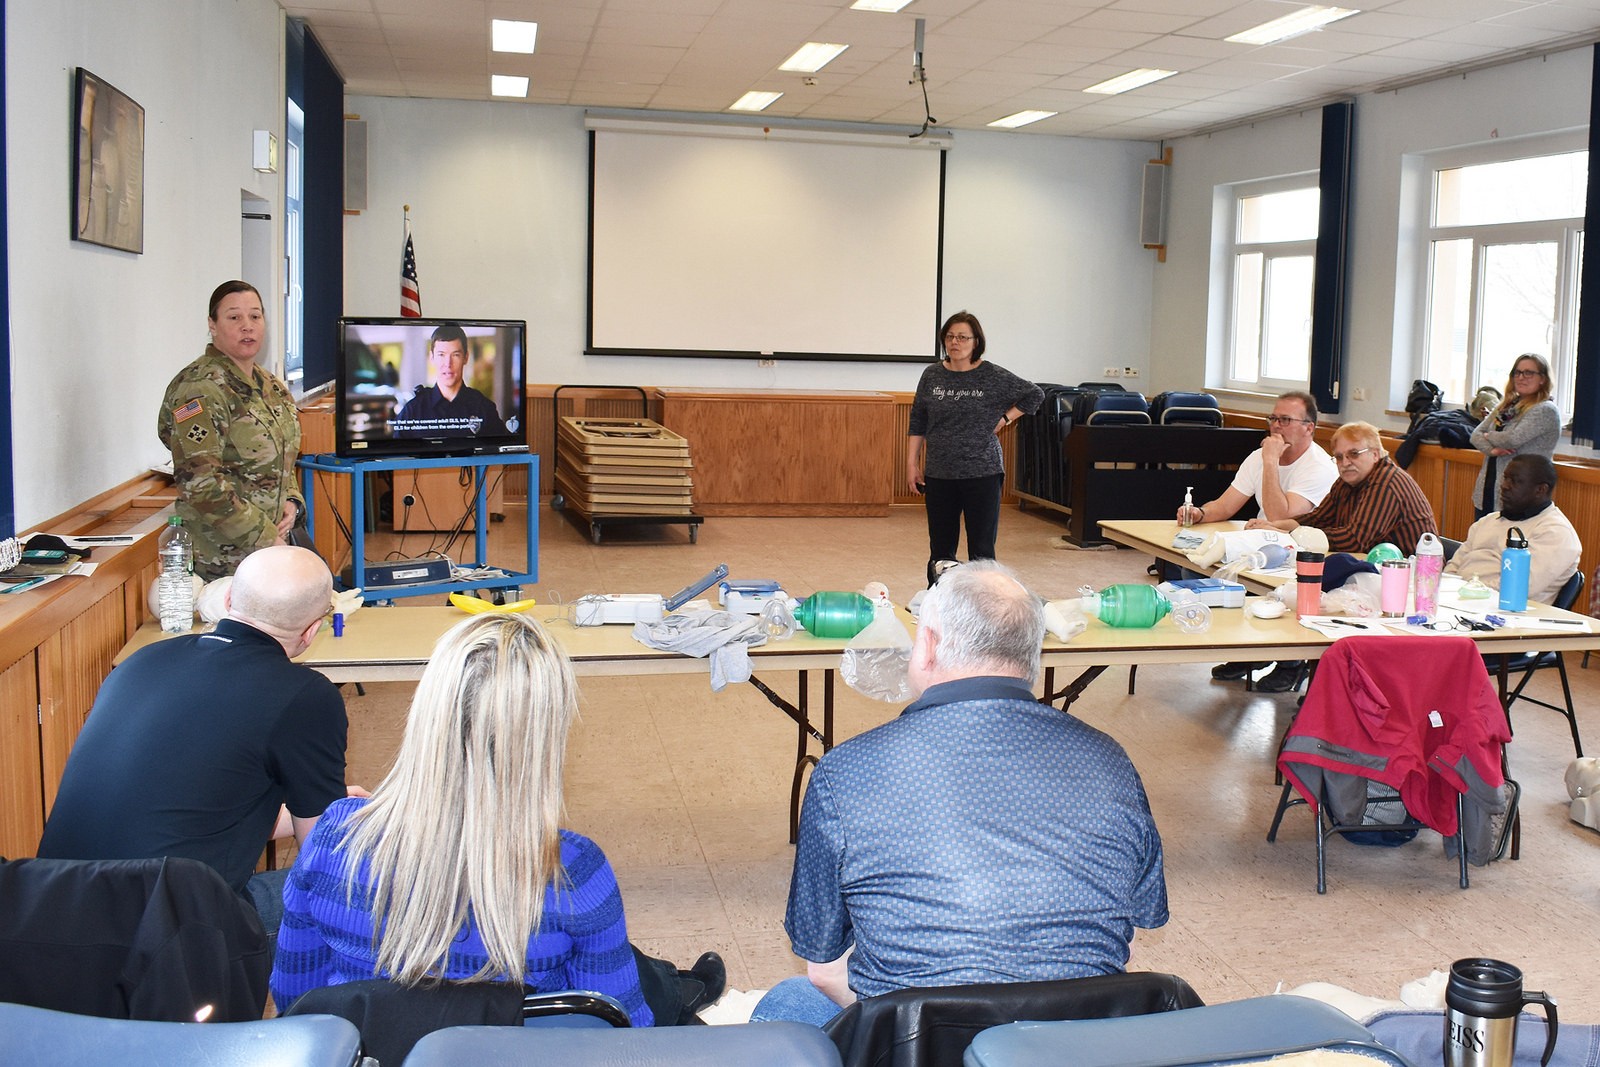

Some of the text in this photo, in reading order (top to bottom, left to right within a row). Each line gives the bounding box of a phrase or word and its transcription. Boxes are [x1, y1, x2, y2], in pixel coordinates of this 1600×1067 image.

[932, 386, 945, 400] stay
[954, 389, 971, 400] you
[971, 389, 985, 397] are
